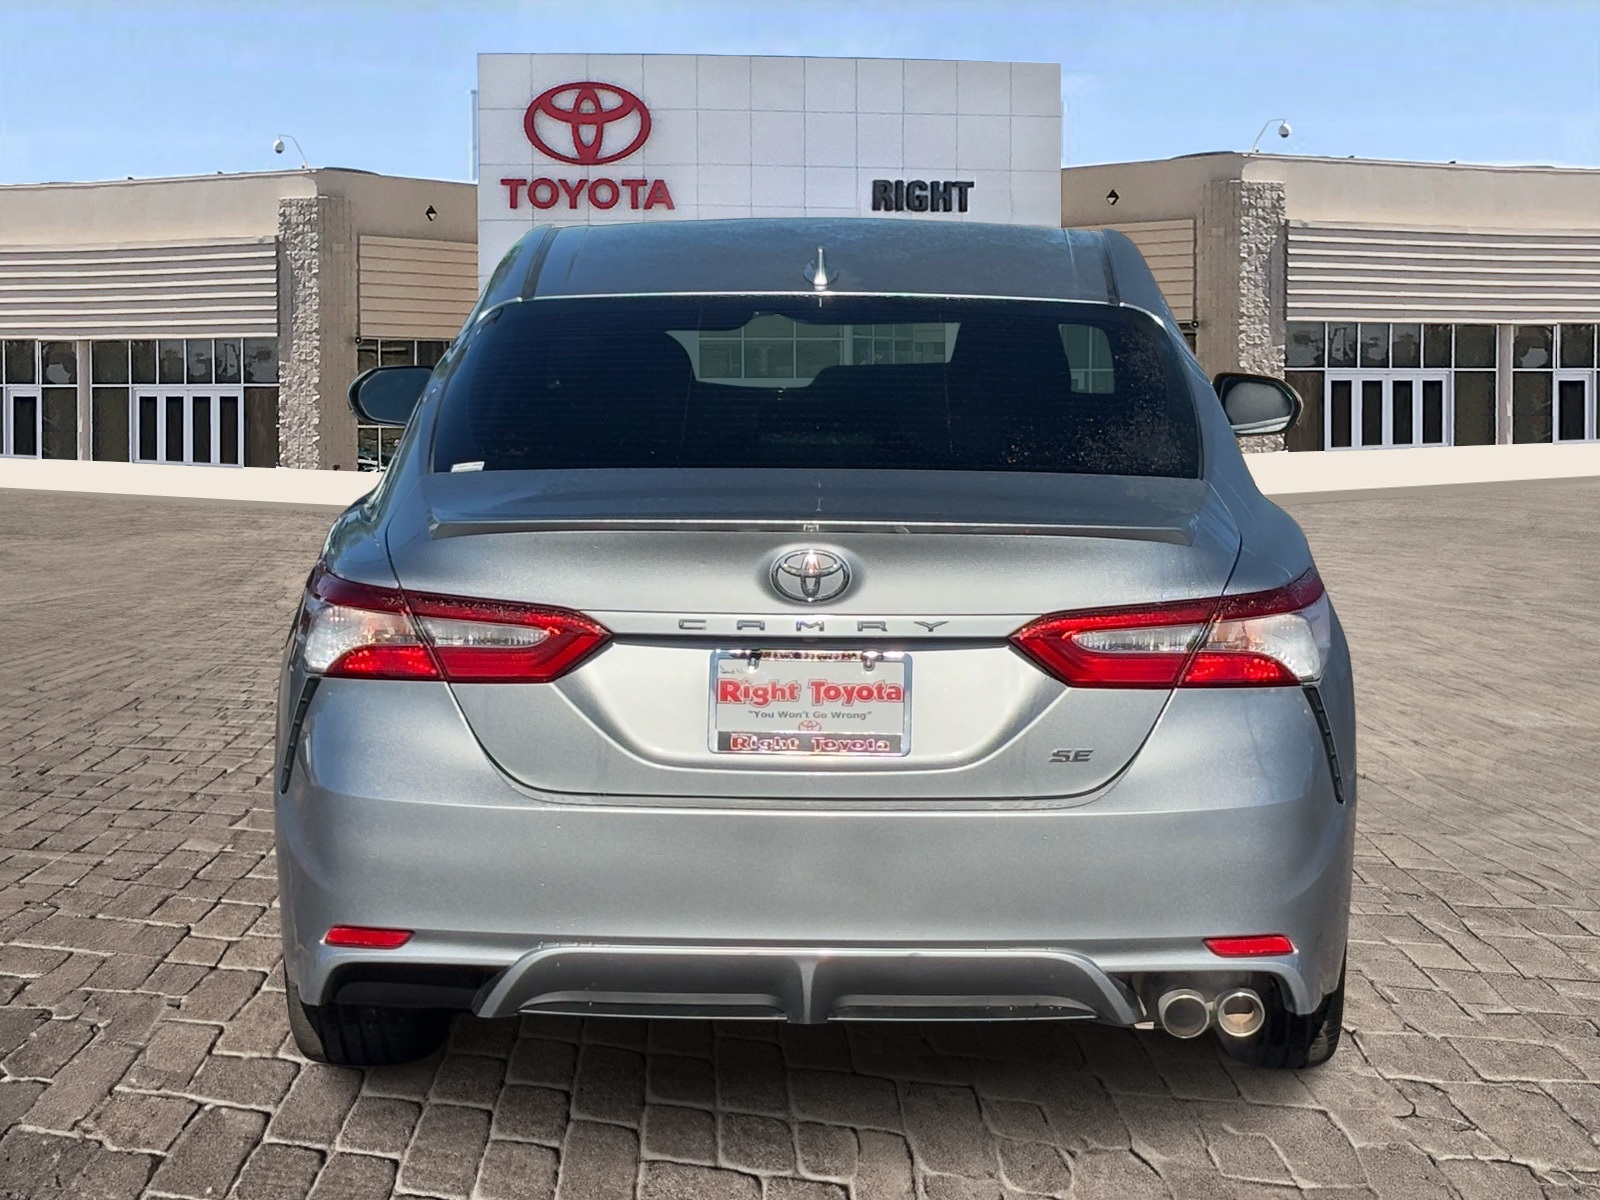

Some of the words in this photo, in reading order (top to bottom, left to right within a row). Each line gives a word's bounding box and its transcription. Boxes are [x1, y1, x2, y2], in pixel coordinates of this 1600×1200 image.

[501, 178, 675, 210] TOYOTA
[872, 179, 975, 213] RIGHT
[679, 620, 949, 633] CAMRY
[718, 679, 801, 706] Right
[809, 680, 904, 706] Toyota
[778, 710, 809, 719] Won't
[813, 711, 827, 720] Go
[730, 734, 799, 751] Right
[811, 737, 890, 753] Toyota
[1049, 749, 1094, 763] SE
